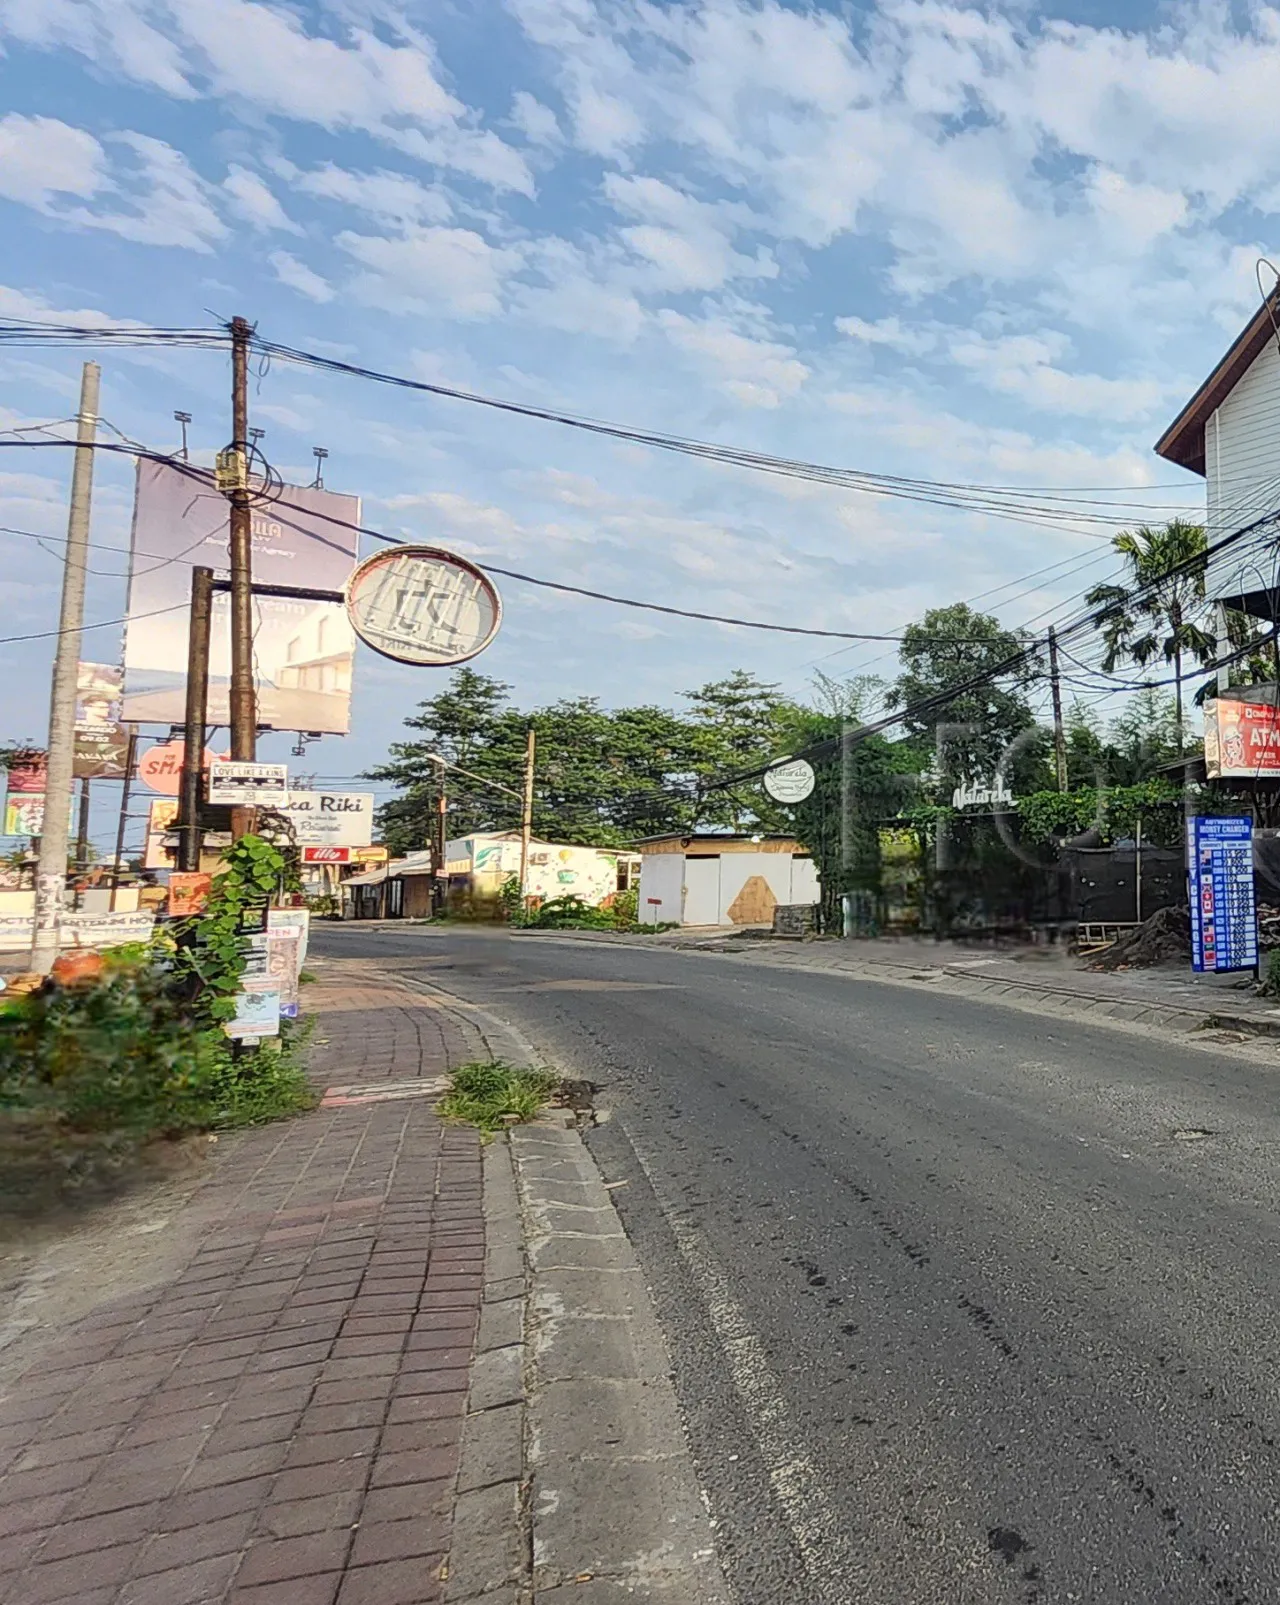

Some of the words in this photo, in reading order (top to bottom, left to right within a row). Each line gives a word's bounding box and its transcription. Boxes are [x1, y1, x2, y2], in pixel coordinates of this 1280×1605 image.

[1249, 727, 1280, 747] ATM
[213, 767, 235, 776] LOVE
[240, 768, 255, 777] LIKE
[266, 769, 285, 777] KING
[319, 796, 363, 812] Riki
[1199, 825, 1221, 834] MONEY
[1222, 825, 1250, 834] CHANGER
[312, 848, 342, 860] illy
[1187, 823, 1197, 880] MONEY
[1190, 884, 1201, 965] CHANGER
